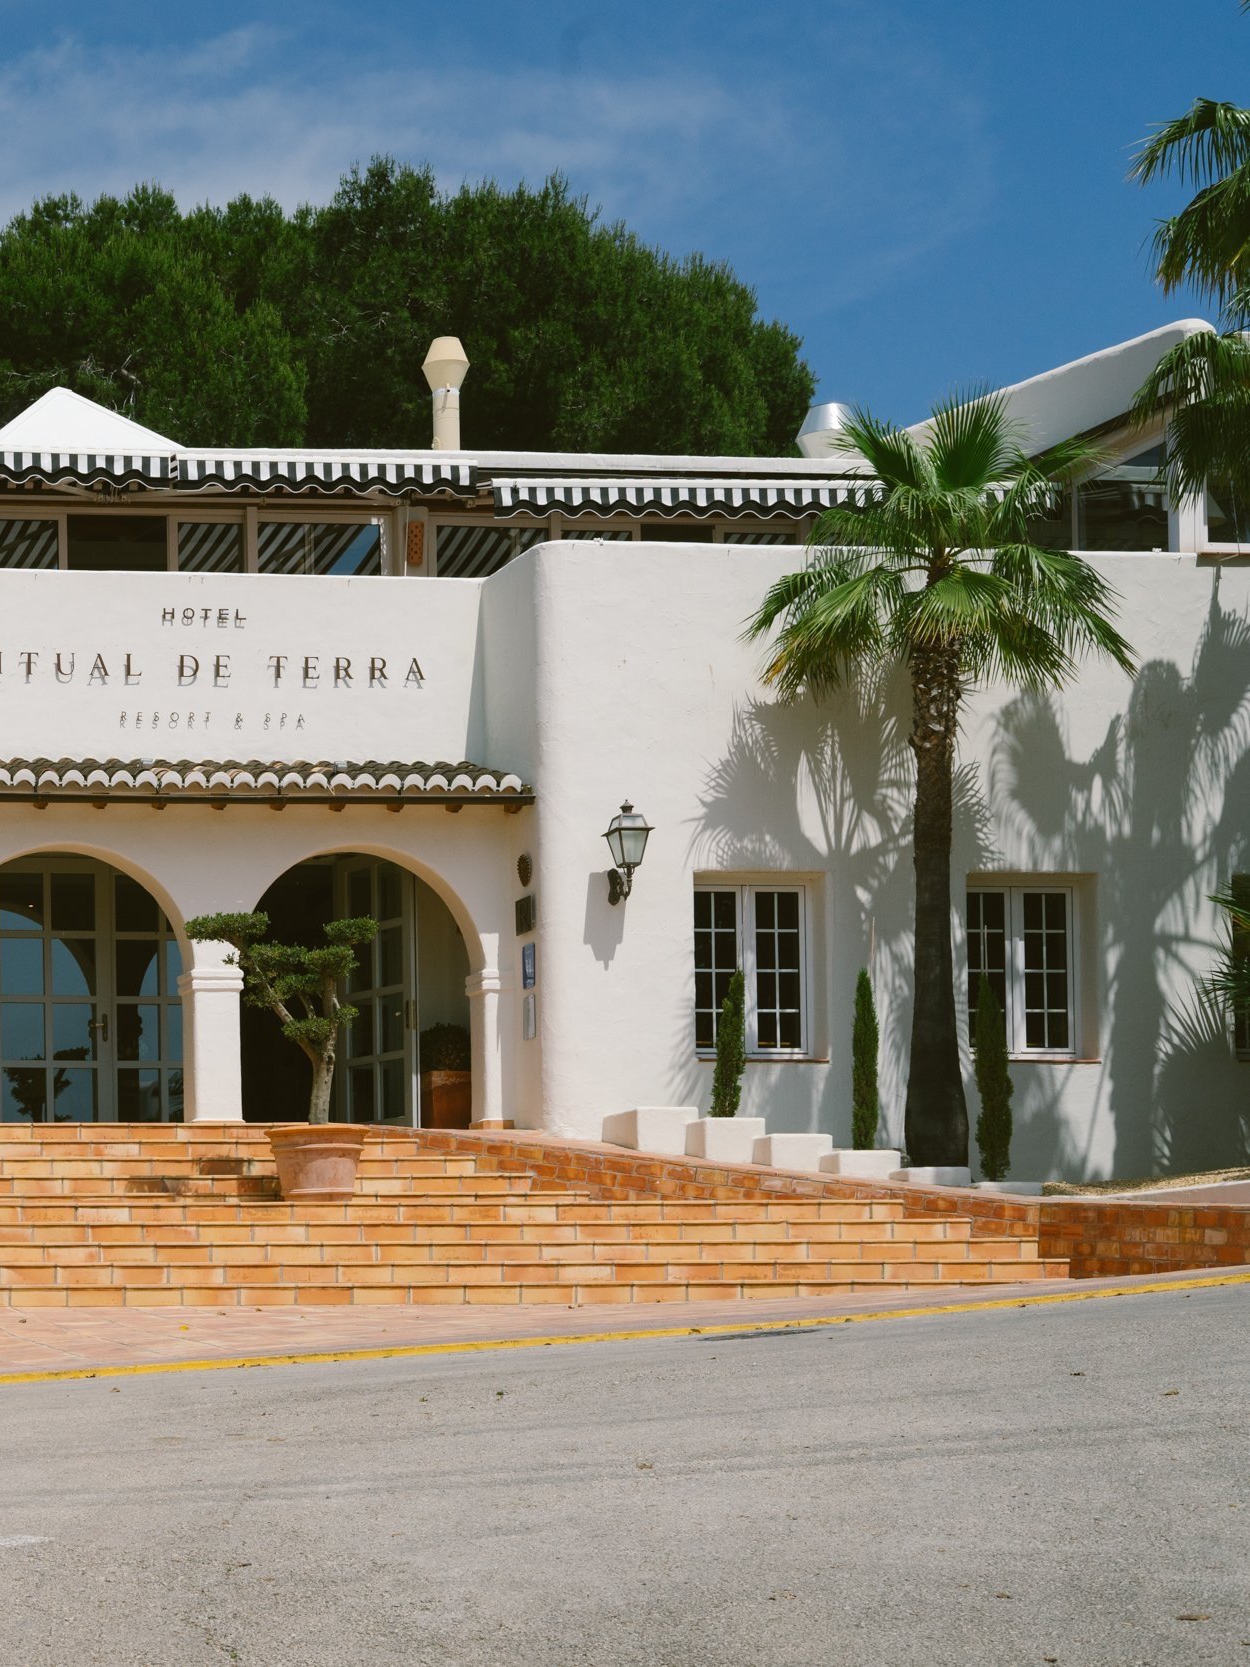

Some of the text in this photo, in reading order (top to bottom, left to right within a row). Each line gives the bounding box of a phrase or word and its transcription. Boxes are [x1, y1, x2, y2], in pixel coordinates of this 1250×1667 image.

[163, 607, 247, 620] HOTEL
[179, 654, 232, 678] DE
[269, 655, 427, 681] TERRA
[120, 711, 211, 722] RESORT
[264, 712, 306, 723] SPA
